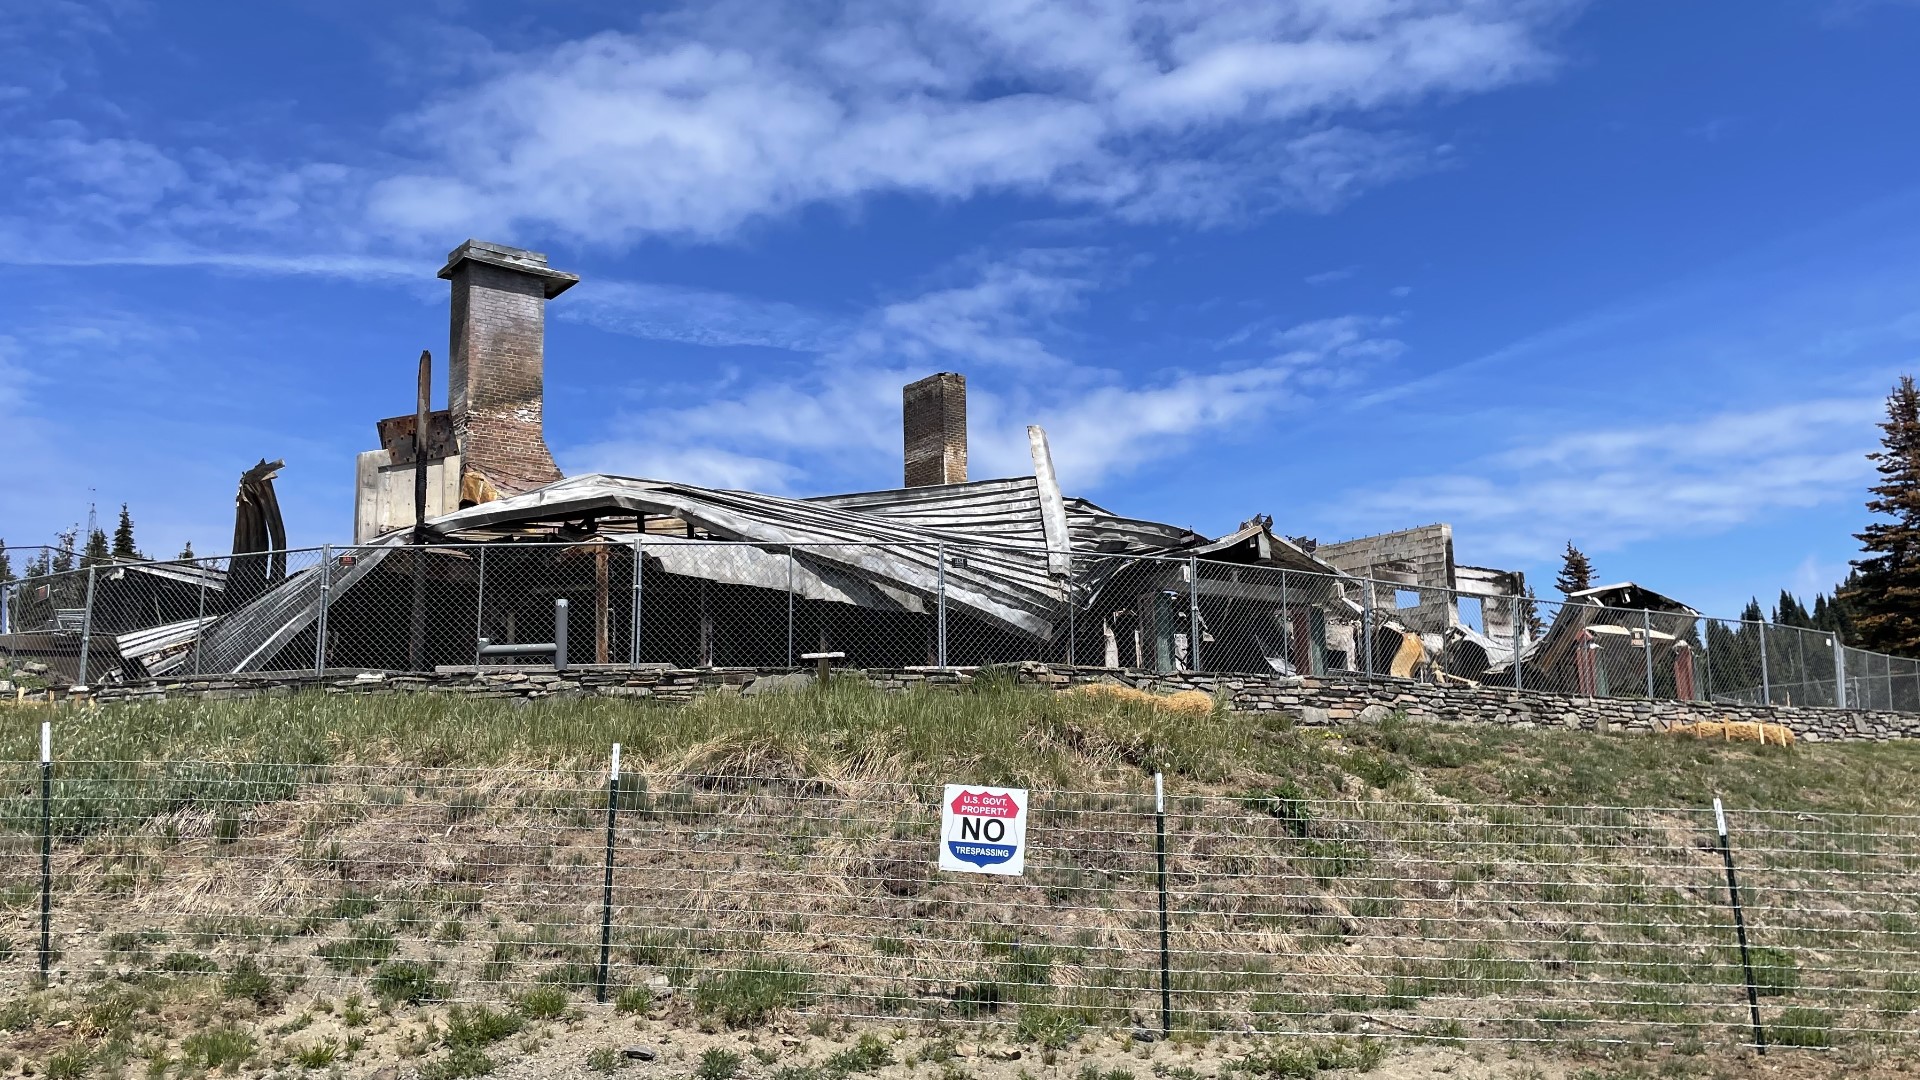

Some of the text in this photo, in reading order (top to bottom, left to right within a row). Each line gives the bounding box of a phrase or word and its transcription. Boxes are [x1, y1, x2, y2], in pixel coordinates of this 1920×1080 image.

[963, 796, 1007, 806] U.S. GOVT.
[961, 805, 1008, 815] PROPERTY
[961, 816, 1005, 842] NO
[955, 846, 1009, 857] TRESPASSING
